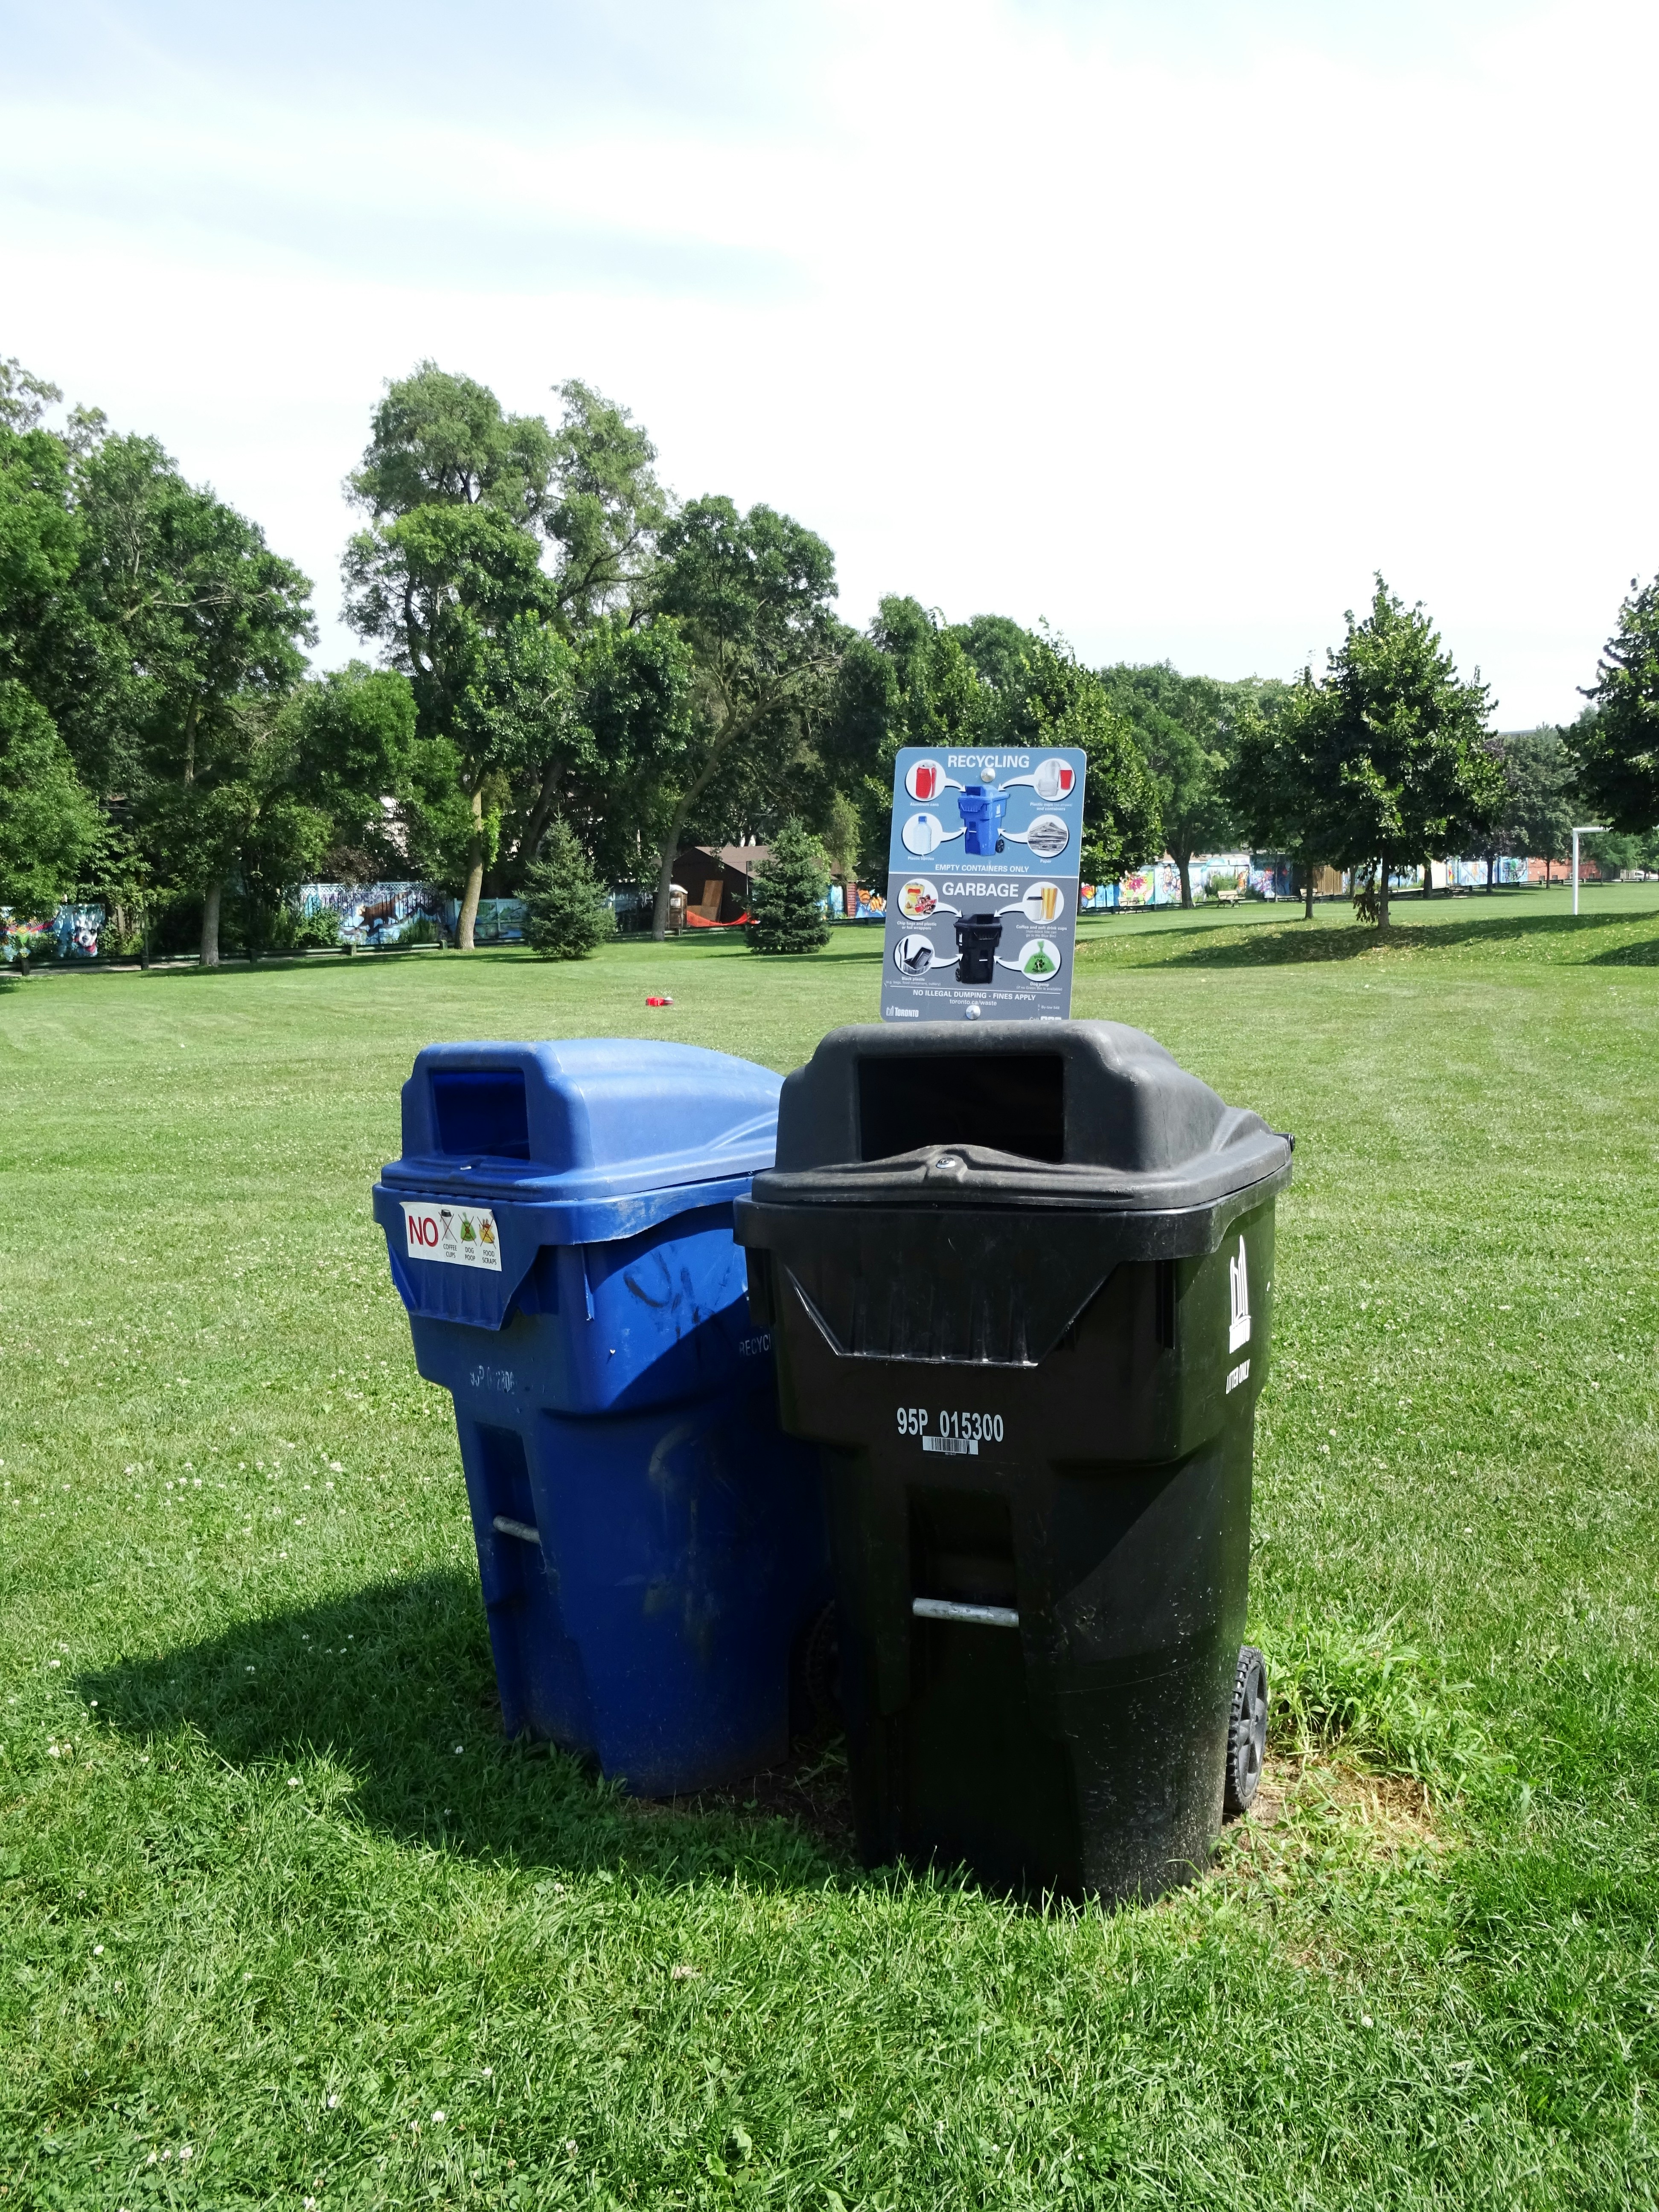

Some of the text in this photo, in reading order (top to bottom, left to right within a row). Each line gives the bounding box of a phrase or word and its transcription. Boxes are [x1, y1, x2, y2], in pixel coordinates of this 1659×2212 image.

[948, 755, 1029, 768] RECYCLING
[942, 882, 1019, 897] GARBAGE
[895, 1007, 919, 1018] TORONTO
[408, 1215, 439, 1247] NO
[443, 1243, 457, 1252] COFFEE
[482, 1257, 497, 1265] SCRAPS
[1225, 1359, 1250, 1394] LITTER ONLY
[897, 1407, 1003, 1442] 95P 015300
